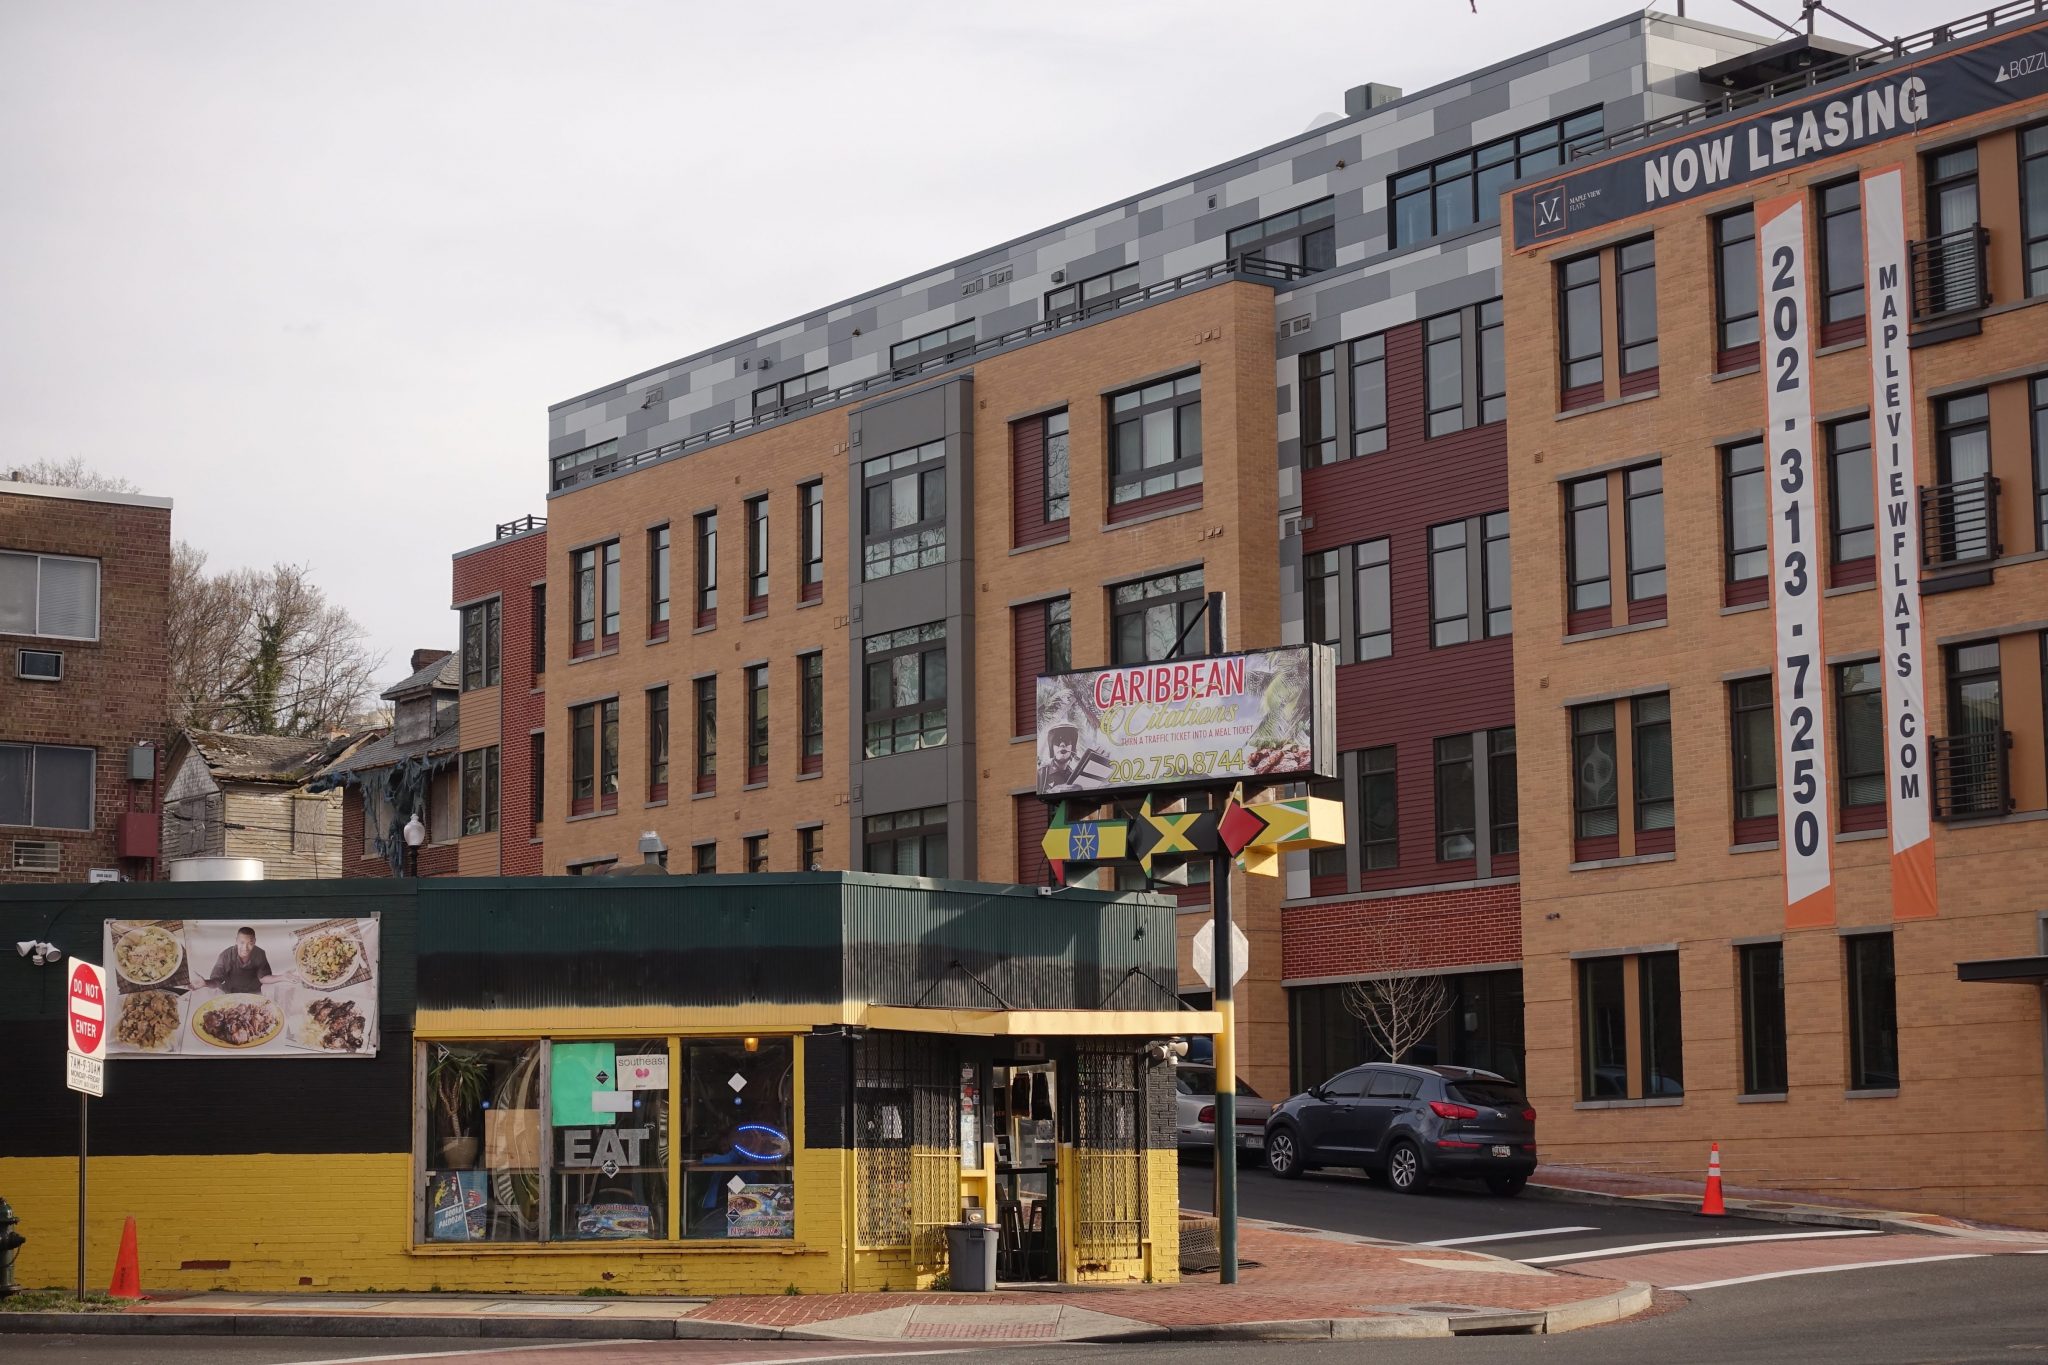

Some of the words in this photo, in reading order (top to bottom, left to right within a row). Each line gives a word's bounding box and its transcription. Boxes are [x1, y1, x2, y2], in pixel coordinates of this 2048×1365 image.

[1645, 135, 1733, 203] NOW
[1749, 76, 1928, 172] LEASING
[1569, 192, 1587, 205] MAPLE
[1587, 189, 1601, 199] VIEW
[1569, 202, 1586, 212] FLATS
[1879, 263, 1920, 800] MAPLEVIEWFLATS.COM
[1771, 245, 1819, 857] 202.313.7250
[1094, 657, 1246, 709] CARIBBEAN
[1102, 692, 1239, 743] Citations
[1139, 736, 1144, 745] A
[1145, 733, 1169, 744] TRAFFIC
[1171, 731, 1191, 742] TICKET
[1192, 730, 1207, 739] INTO
[1208, 729, 1213, 738] A
[1214, 727, 1231, 737] MEAL
[1233, 725, 1254, 735] TICKET
[1108, 748, 1246, 783] 202.750.8744
[73, 978, 83, 993] DO
[85, 983, 99, 999] NOT
[75, 1019, 97, 1038] ENTER
[618, 1057, 666, 1067] southeast
[564, 1128, 650, 1168] EAT
